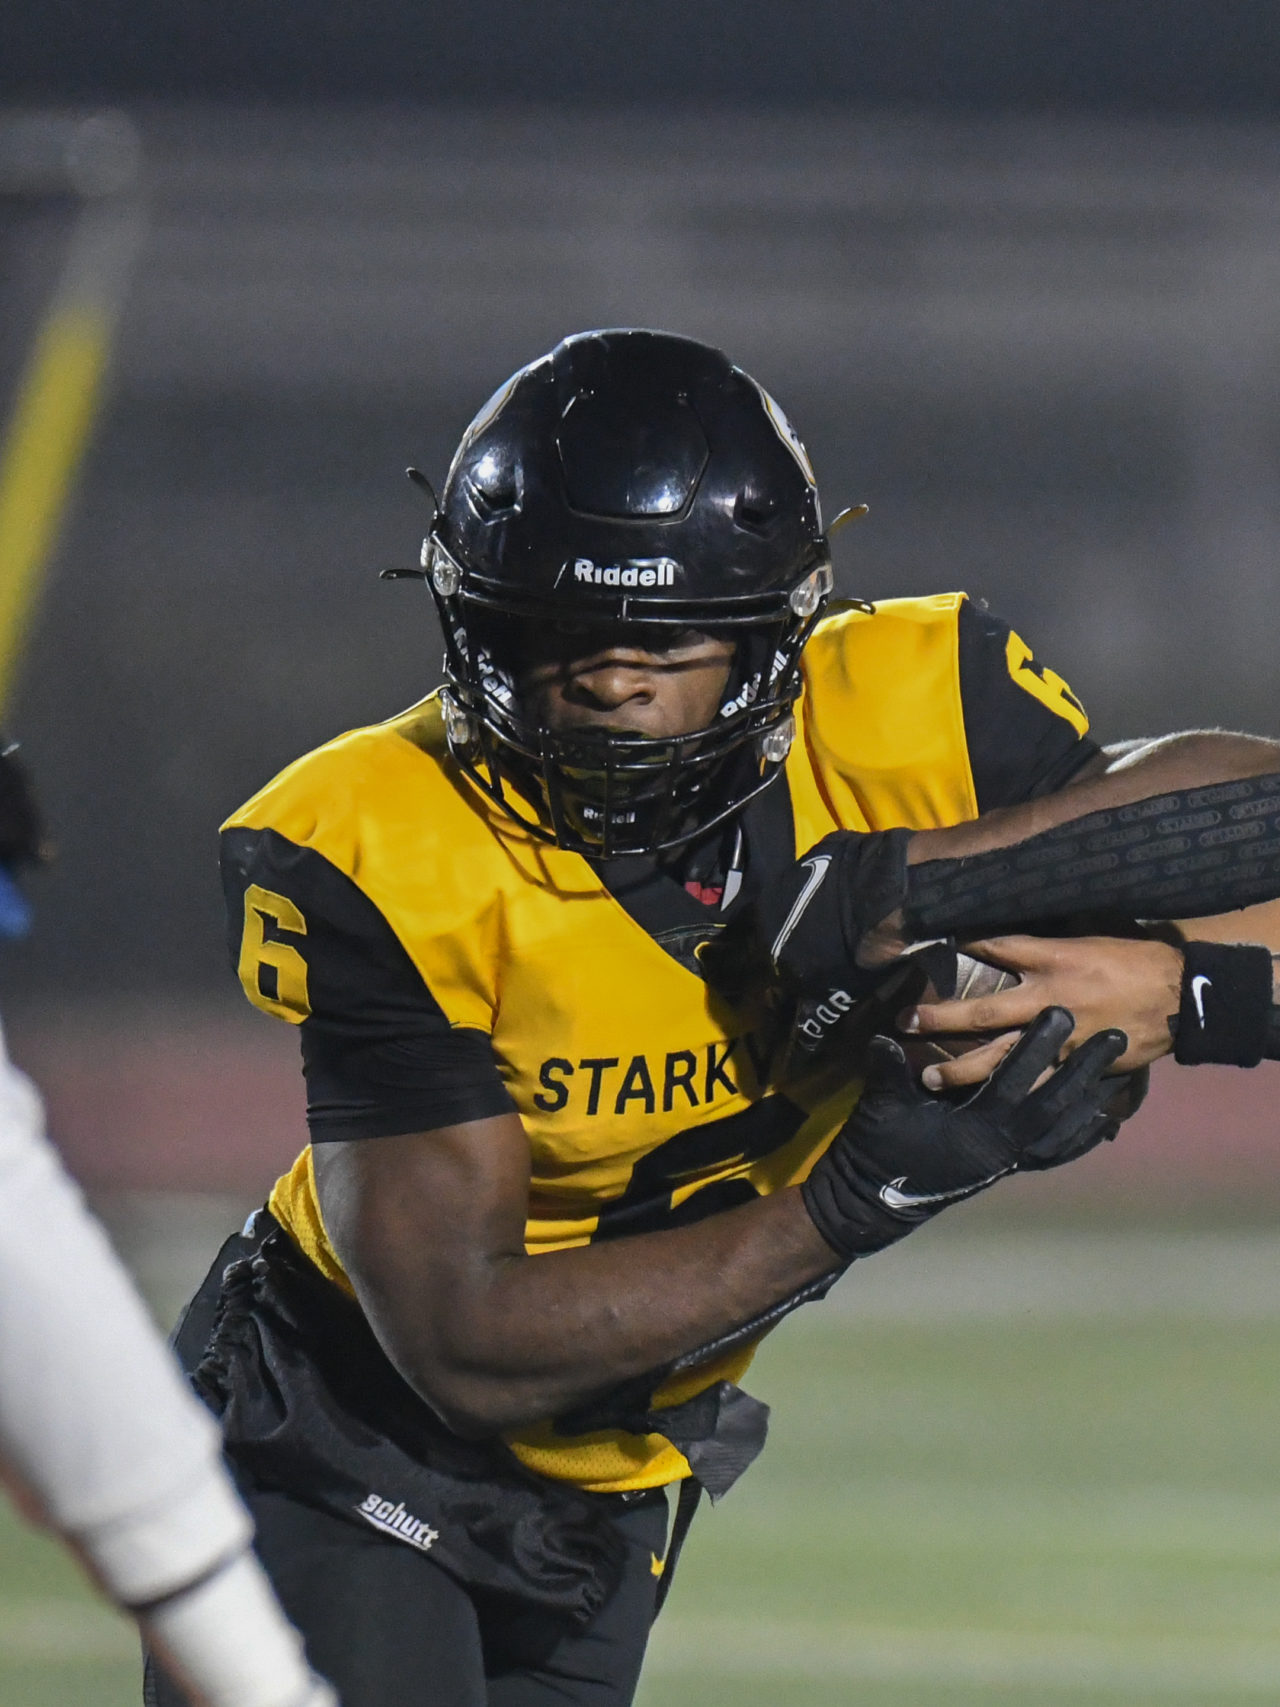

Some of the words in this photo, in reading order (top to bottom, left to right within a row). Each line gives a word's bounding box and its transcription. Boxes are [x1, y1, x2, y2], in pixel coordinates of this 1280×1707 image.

[574, 558, 674, 587] Riddell
[583, 807, 636, 824] Riell
[237, 884, 312, 1025] 6
[358, 1493, 439, 1551] schutt
